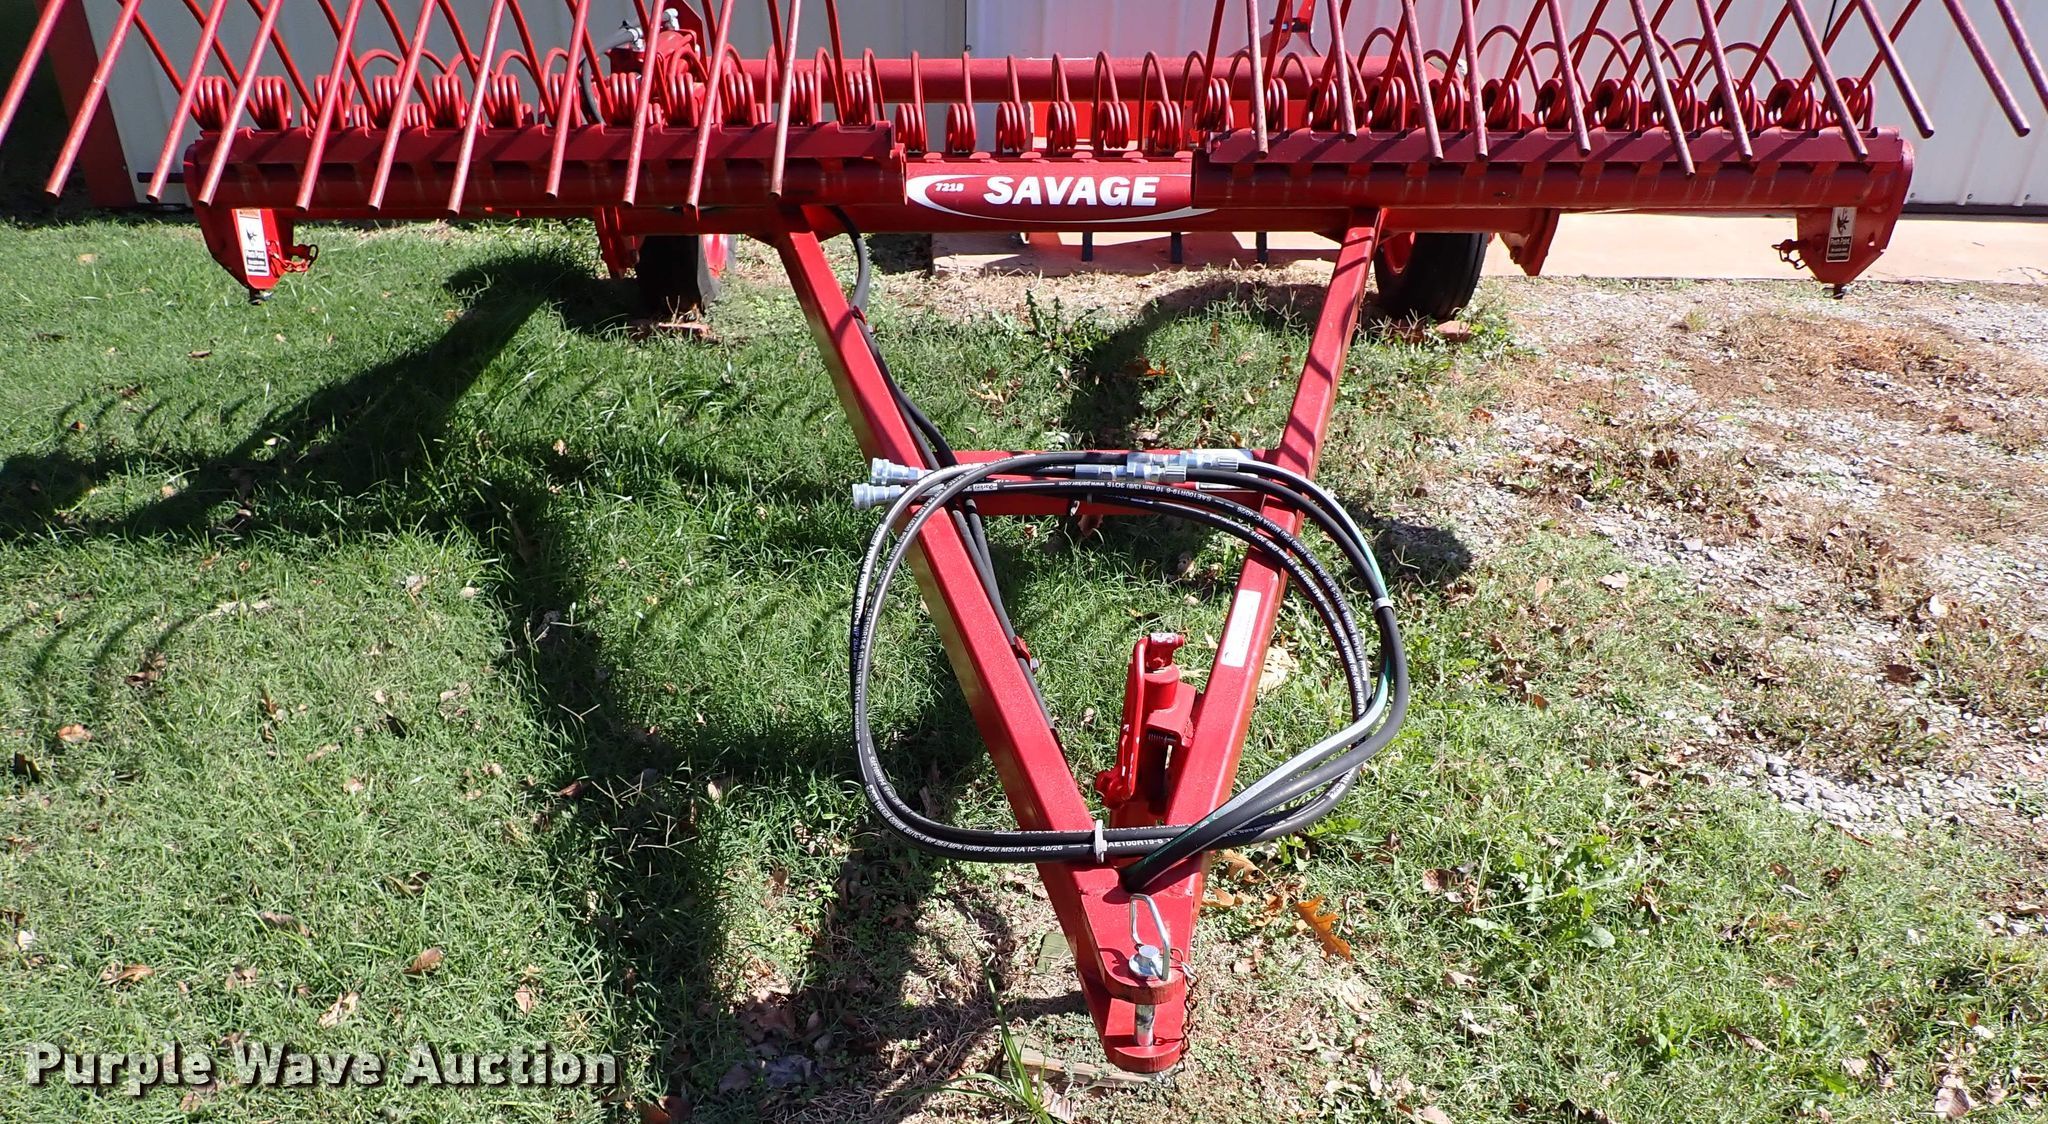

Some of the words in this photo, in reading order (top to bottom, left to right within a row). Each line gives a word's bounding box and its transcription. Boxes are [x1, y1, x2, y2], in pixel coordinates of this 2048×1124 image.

[934, 182, 964, 192] 7218
[983, 176, 1160, 206] SAVAGE
[1263, 518, 1281, 533] MSHA
[1306, 553, 1317, 566] MPa
[948, 842, 963, 850] MPa
[1106, 838, 1163, 848] AE100R19-6
